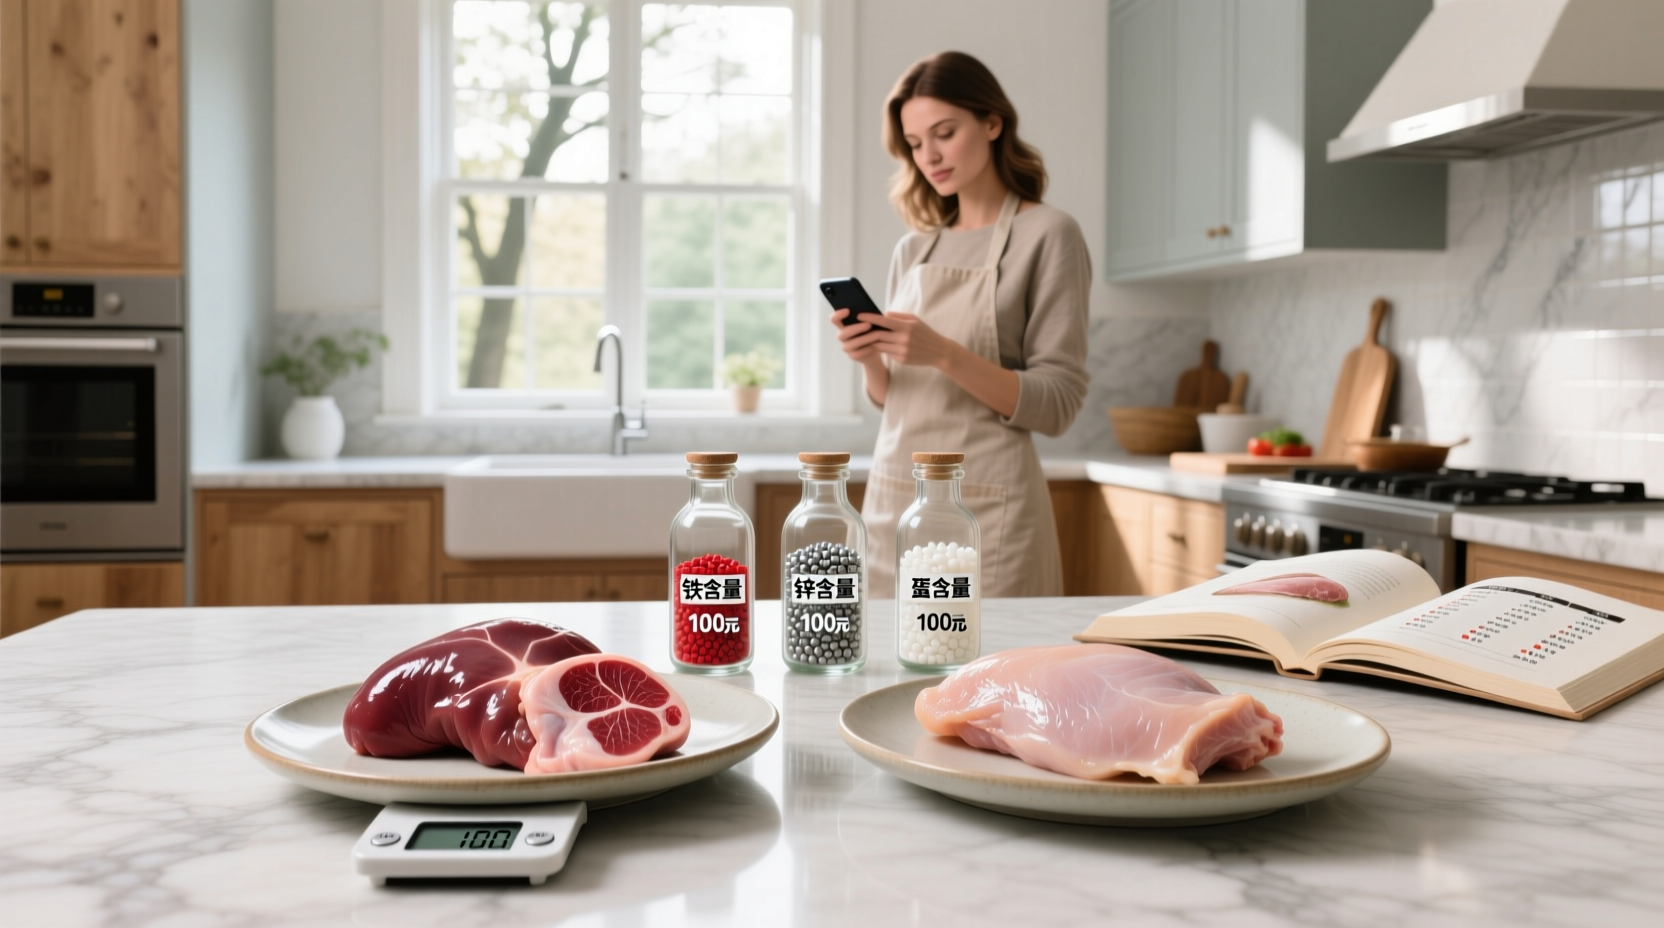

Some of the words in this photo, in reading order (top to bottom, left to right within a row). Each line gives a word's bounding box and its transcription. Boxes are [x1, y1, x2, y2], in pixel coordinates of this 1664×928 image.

[682, 578, 742, 600] 铁含量
[688, 613, 740, 634] 100元
[800, 613, 850, 634] 100元
[917, 612, 967, 632] 100元
[460, 830, 511, 848] 100
